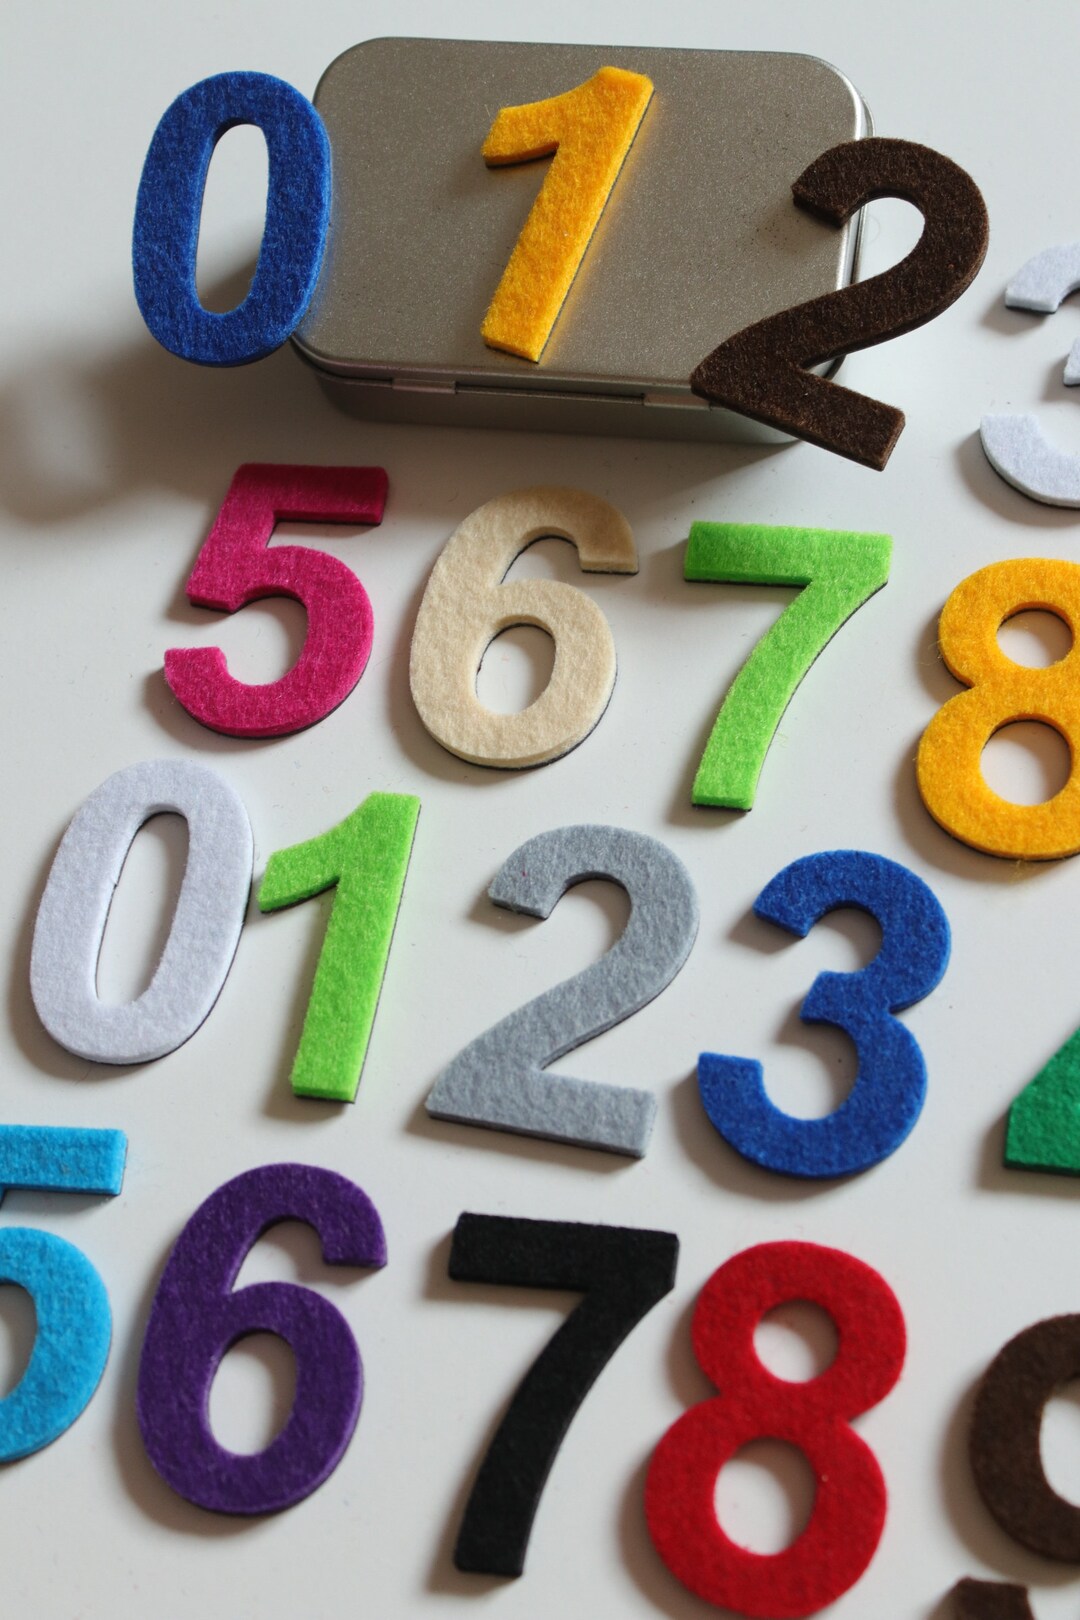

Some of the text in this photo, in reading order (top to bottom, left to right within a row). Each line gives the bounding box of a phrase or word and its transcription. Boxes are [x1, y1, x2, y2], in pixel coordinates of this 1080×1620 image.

[132, 70, 331, 367] 0
[481, 66, 654, 363] 1
[692, 137, 988, 471] 2
[164, 463, 1080, 860] 5 6 7 8
[30, 759, 254, 1065] 0
[257, 792, 421, 1103] 1
[426, 823, 700, 1158] 2
[698, 849, 951, 1179] 3
[136, 1162, 388, 1515] 6
[448, 1211, 679, 1577] 7
[645, 1240, 906, 1620] 8
